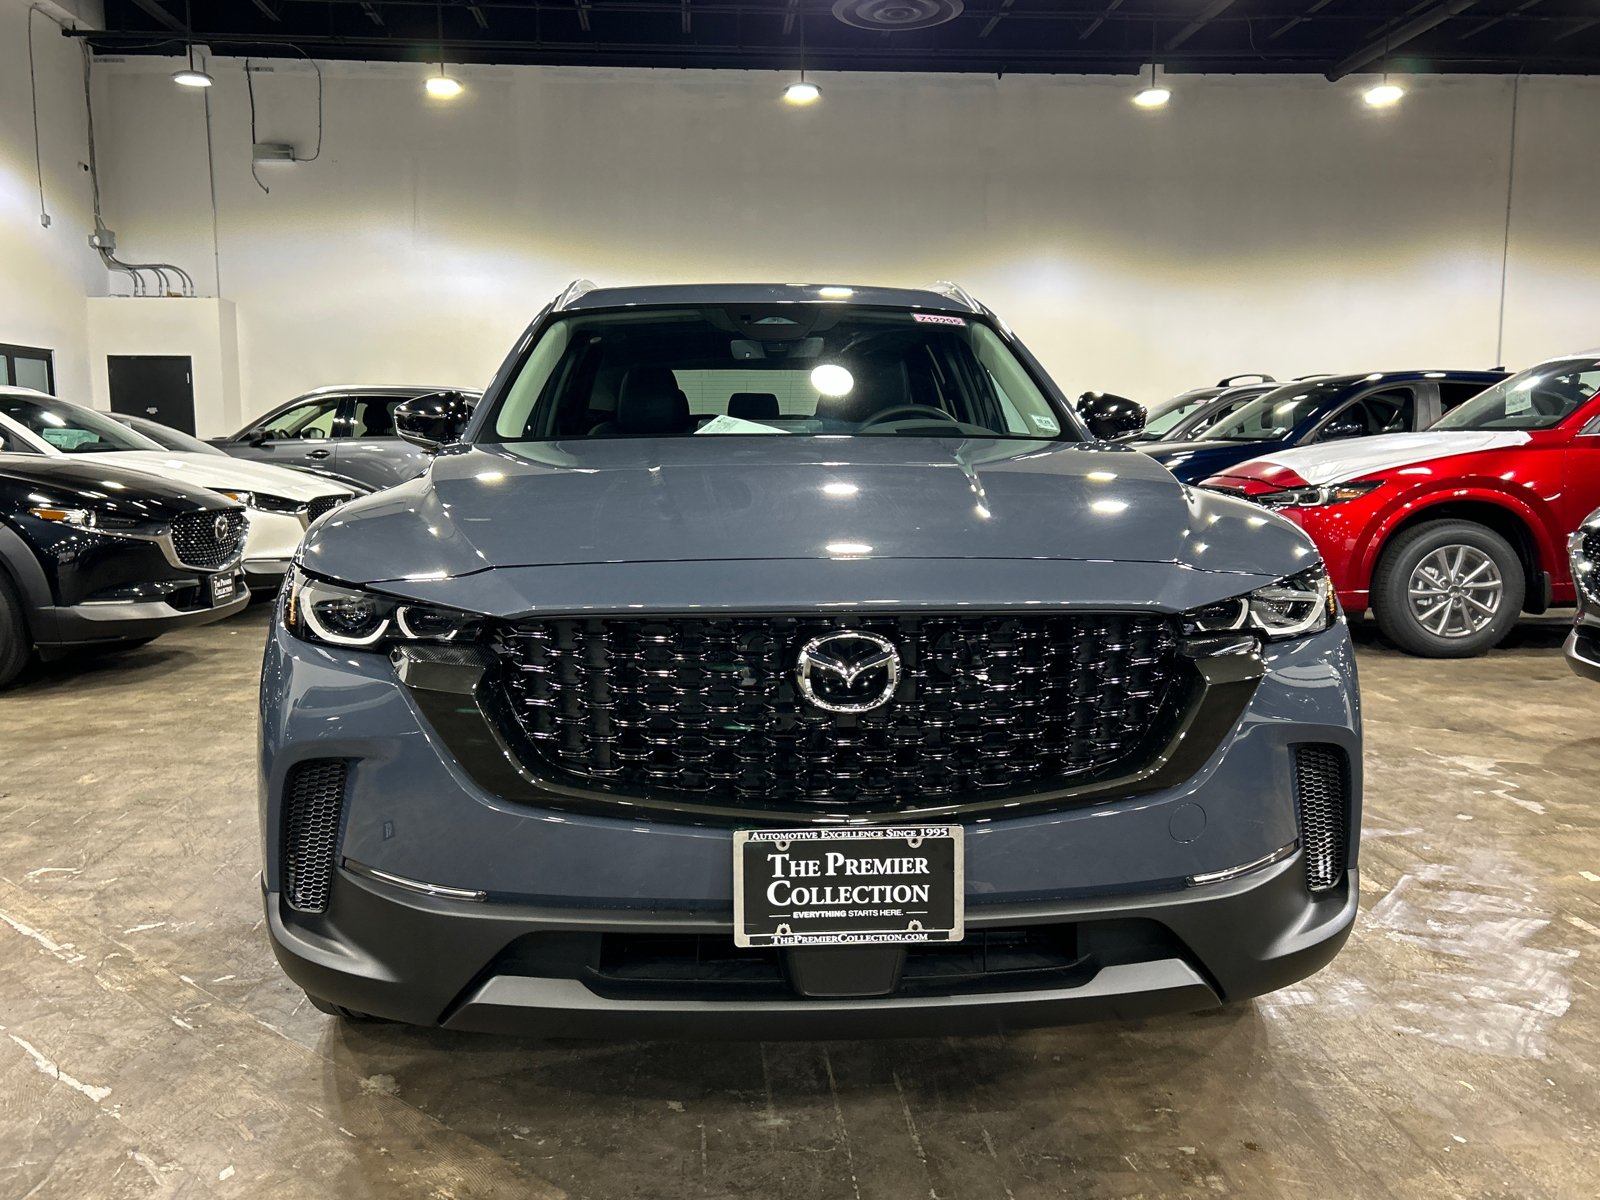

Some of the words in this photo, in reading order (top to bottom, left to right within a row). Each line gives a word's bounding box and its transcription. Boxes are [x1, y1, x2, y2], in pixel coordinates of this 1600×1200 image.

[751, 831, 818, 841] AUTOMOTIVE
[820, 830, 884, 840] EXCELLENCE
[885, 828, 917, 838] SINCE
[919, 827, 948, 837] 1995
[767, 853, 821, 878] THE
[825, 852, 930, 876] PREMIER
[766, 879, 930, 906] COLLECTION
[792, 910, 847, 918] EVERYTHING
[848, 909, 879, 917] STARTS
[879, 908, 904, 917] HERE.
